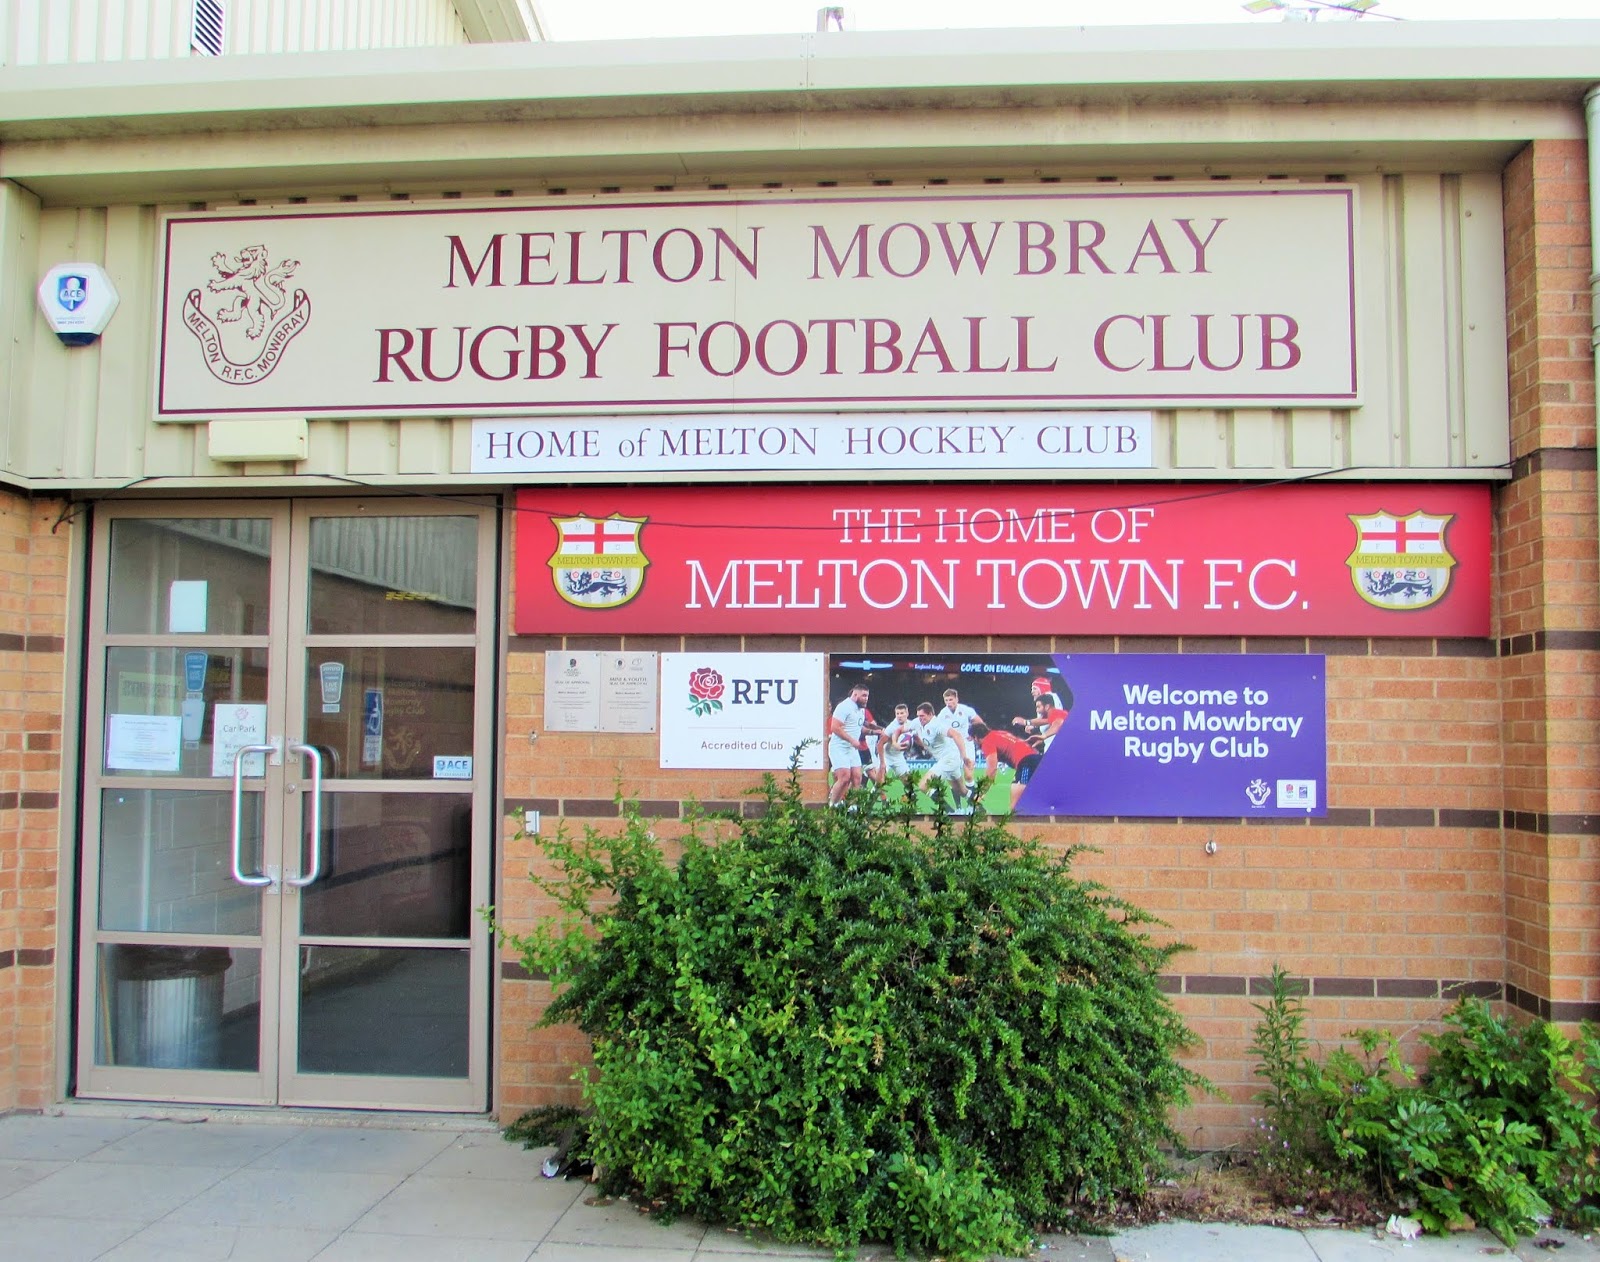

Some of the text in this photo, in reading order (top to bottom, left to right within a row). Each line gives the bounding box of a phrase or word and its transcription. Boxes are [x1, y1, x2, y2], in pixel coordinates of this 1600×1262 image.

[445, 217, 1228, 288] MELTON MOWBRAY
[63, 290, 82, 298] ACE
[187, 310, 305, 381] MELTON R.F.C. MOWBRAY
[373, 313, 1302, 383] RUGBY FOOTBALL CLUB
[487, 425, 1139, 459] HOME of MELTON HOCKEY CLUB
[832, 508, 1155, 544] THE HOME OF
[557, 557, 594, 565] MELTON
[595, 557, 623, 565] TOWN
[1356, 555, 1398, 565] MELTON
[1399, 555, 1428, 565] TOWN
[685, 558, 1309, 611] MELTON TOWN F.C.
[960, 663, 1030, 674] COME ON ENGLAND
[731, 679, 798, 705] RFU
[1122, 683, 1269, 706] Welcome to
[223, 725, 257, 733] Car Park
[1090, 709, 1304, 740] Melton Mowbray
[701, 740, 784, 750] Accredited Club
[1124, 736, 1269, 764] Rugby Club
[446, 760, 468, 770] ACE
